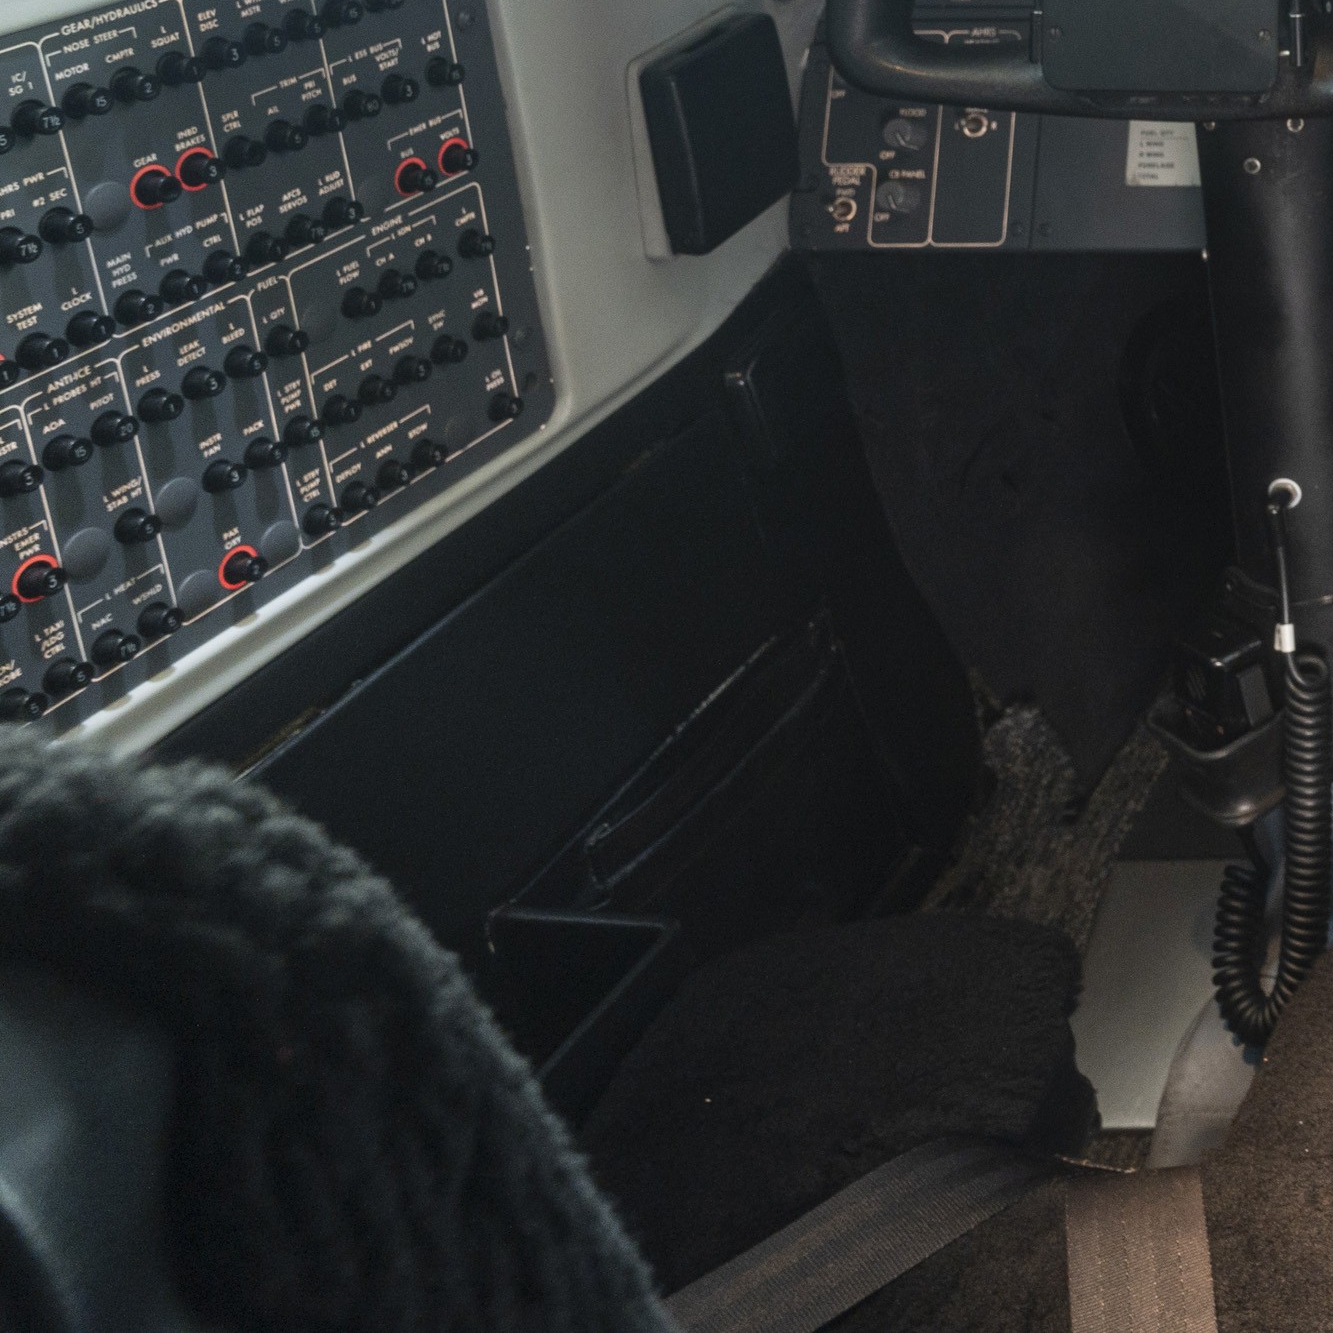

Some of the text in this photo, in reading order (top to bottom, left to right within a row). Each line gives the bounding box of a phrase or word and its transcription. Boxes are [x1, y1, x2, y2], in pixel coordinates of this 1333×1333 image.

[63, 30, 119, 54] NOSE STEER
[151, 31, 180, 48] SQUAT
[55, 62, 89, 81] MOTOR
[174, 133, 206, 152] BRAKES
[133, 154, 157, 168] GEAR
[257, 276, 278, 292] FUEL
[142, 302, 226, 347] ENVIRONMENTAL
